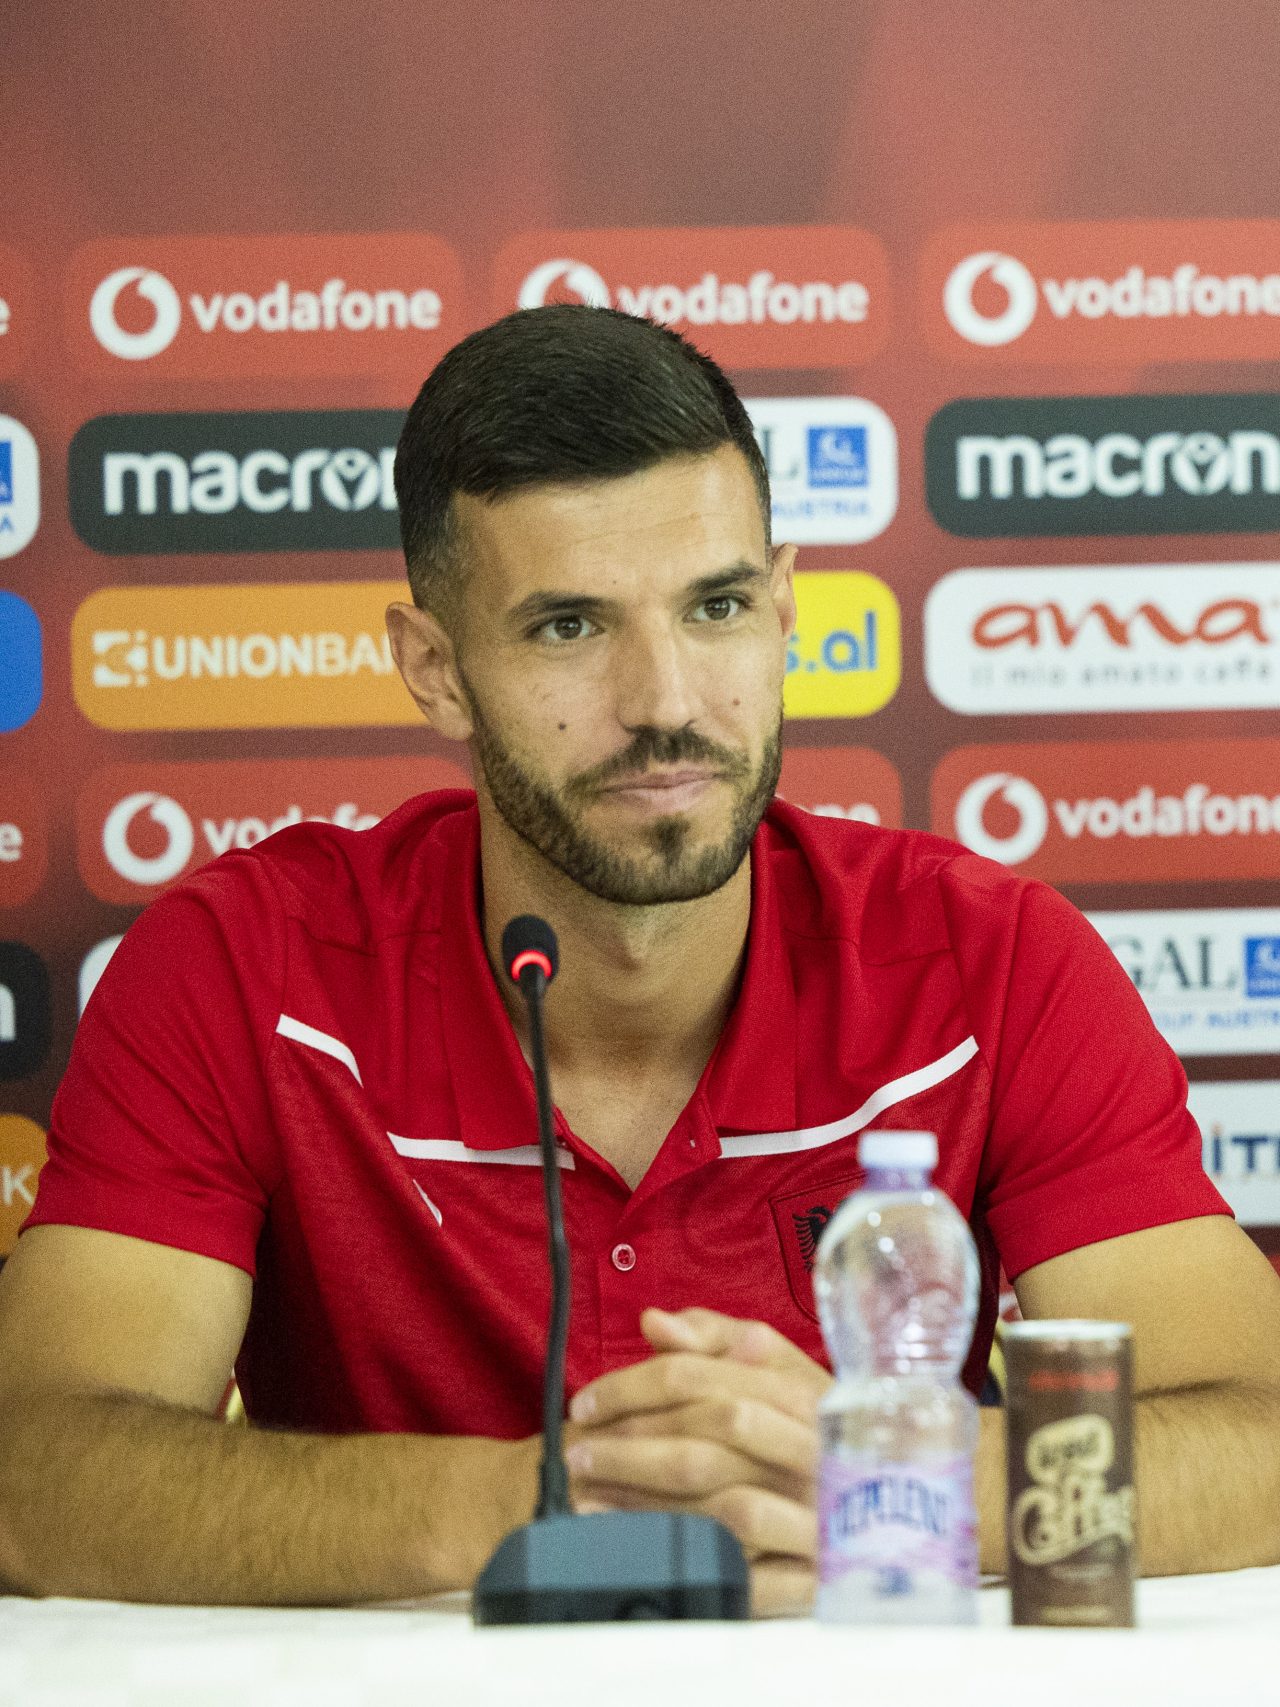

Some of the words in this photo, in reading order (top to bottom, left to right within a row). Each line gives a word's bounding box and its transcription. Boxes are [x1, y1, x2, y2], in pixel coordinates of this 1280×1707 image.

[190, 279, 441, 331] vodafone
[617, 271, 869, 324] vodafone
[970, 597, 1270, 650] ama
[153, 634, 394, 679] UNIONBA
[1110, 935, 1238, 990] GAL
